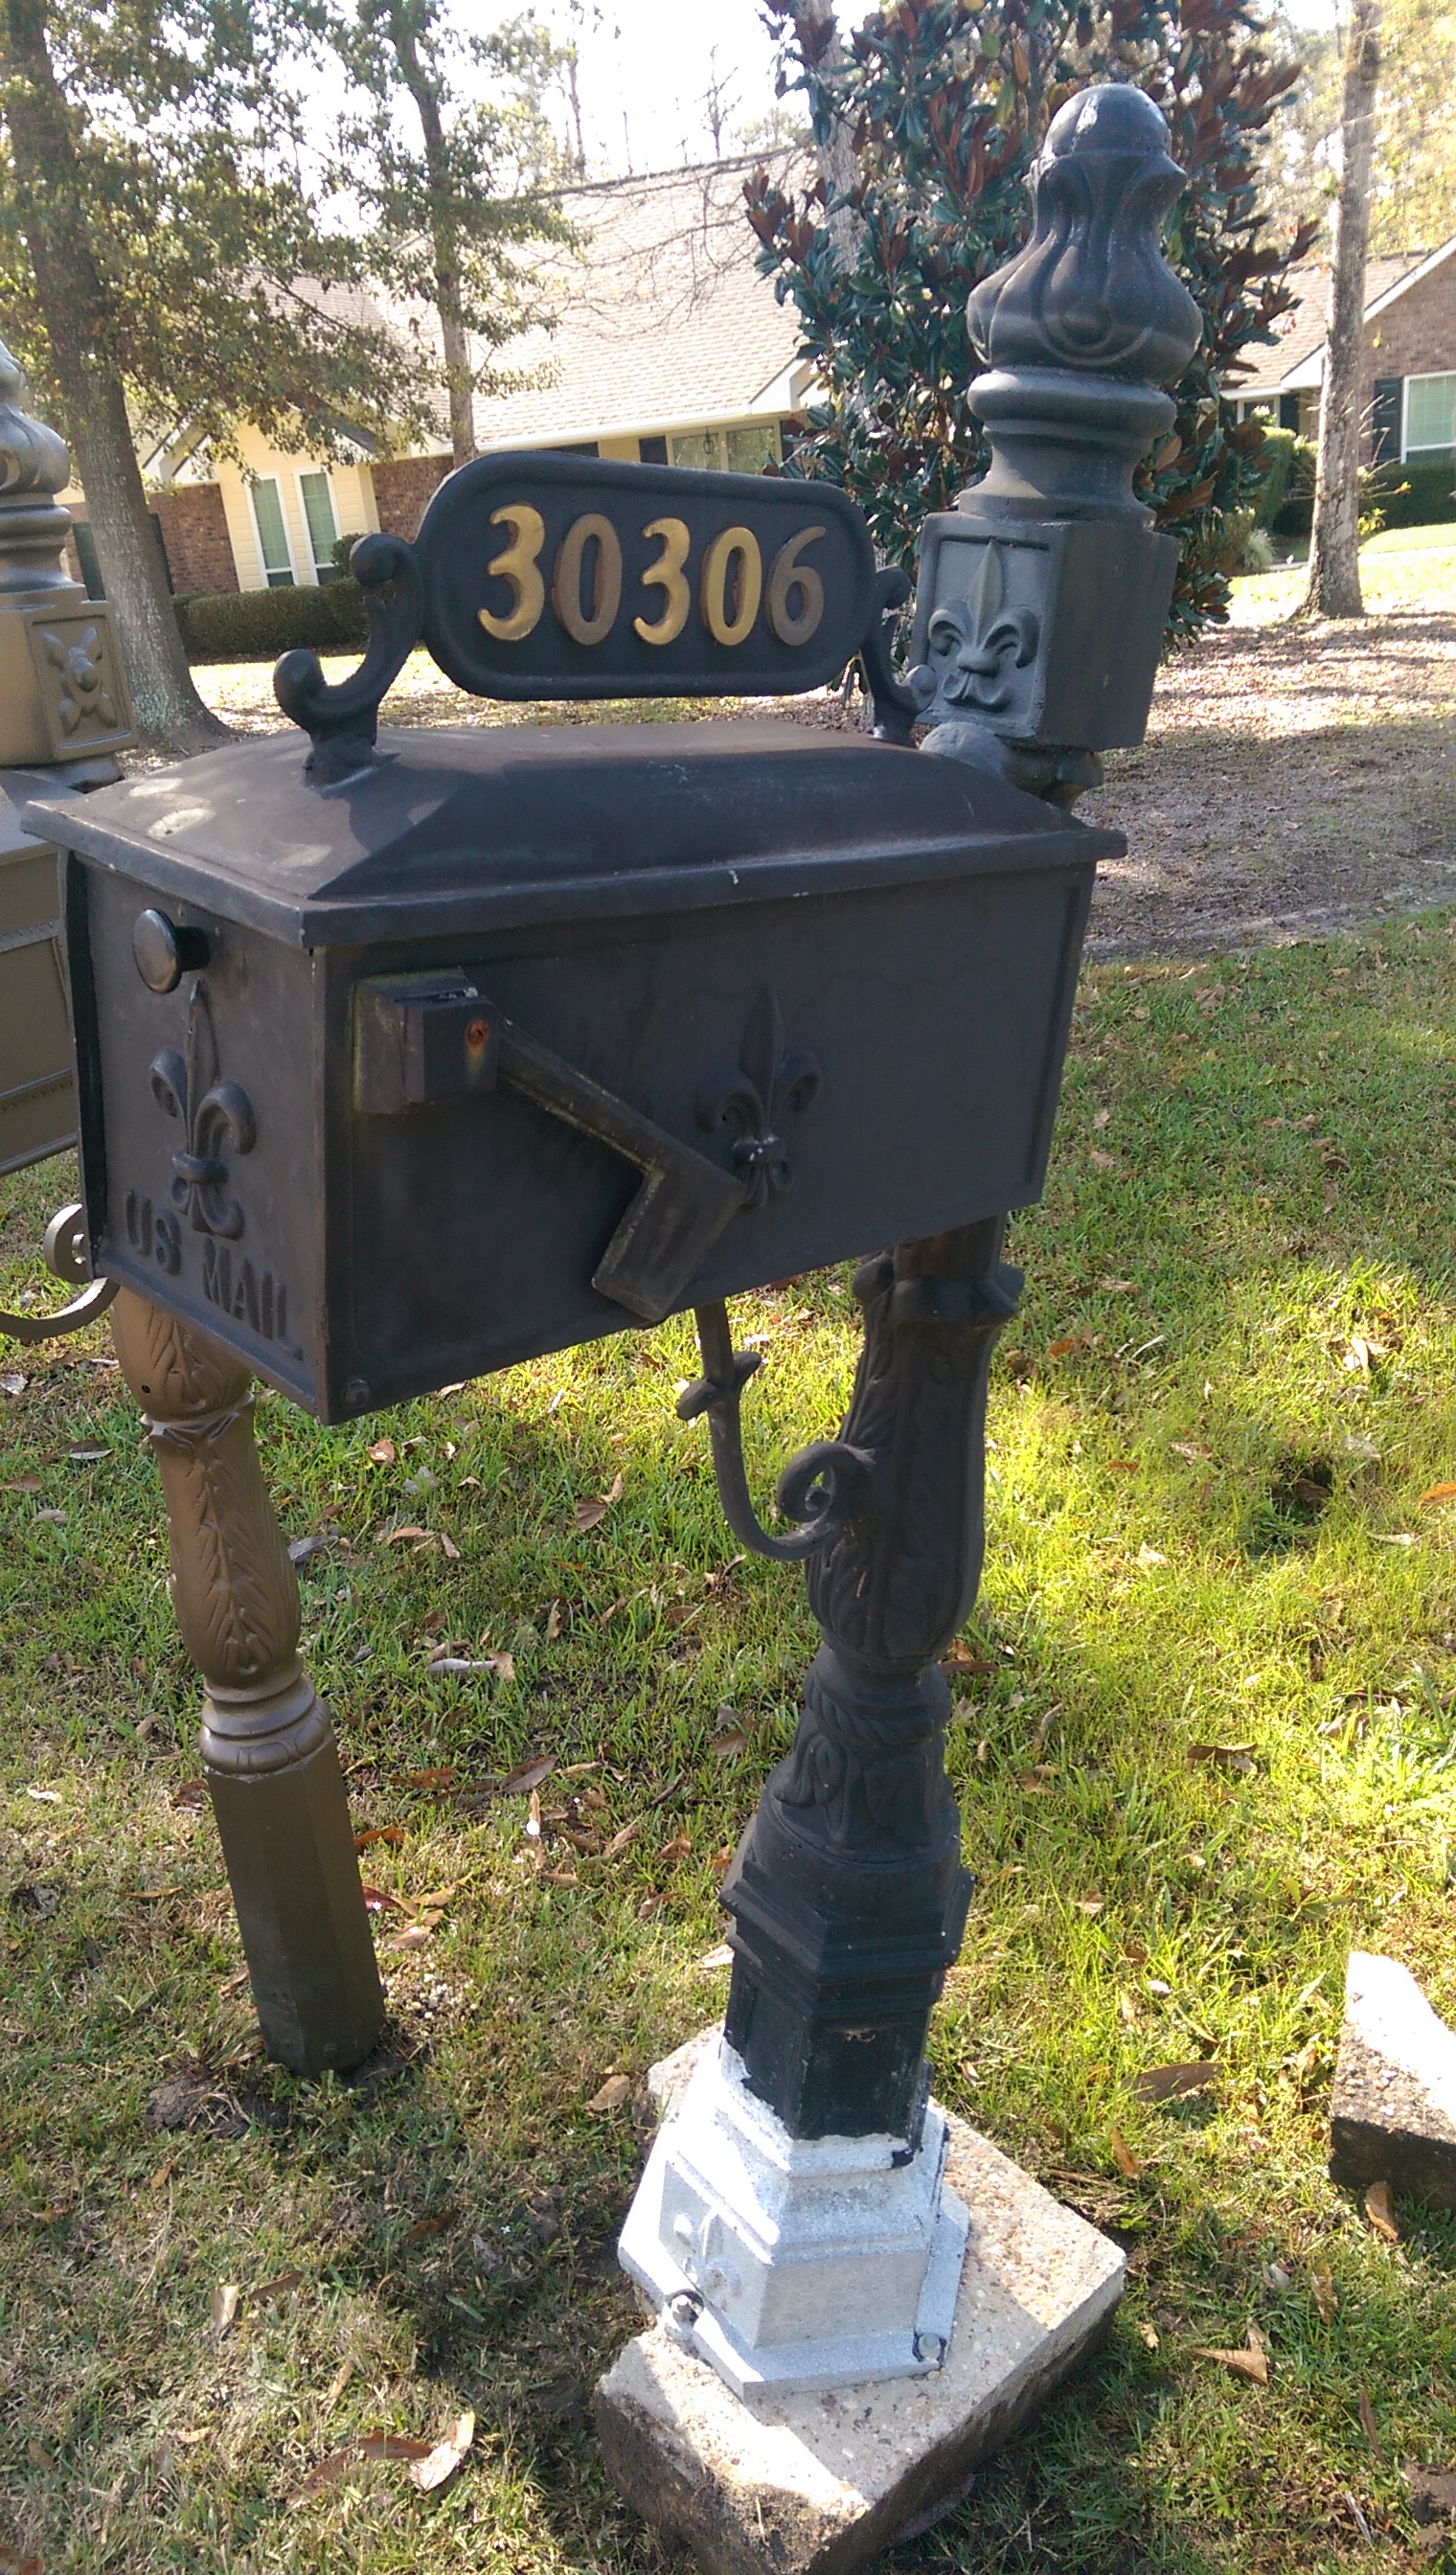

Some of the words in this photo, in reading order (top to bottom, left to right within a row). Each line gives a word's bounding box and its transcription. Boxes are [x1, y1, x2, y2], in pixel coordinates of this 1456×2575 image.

[477, 504, 827, 646] 30306
[125, 1188, 182, 1277] US
[202, 1236, 304, 1362] MAIL
